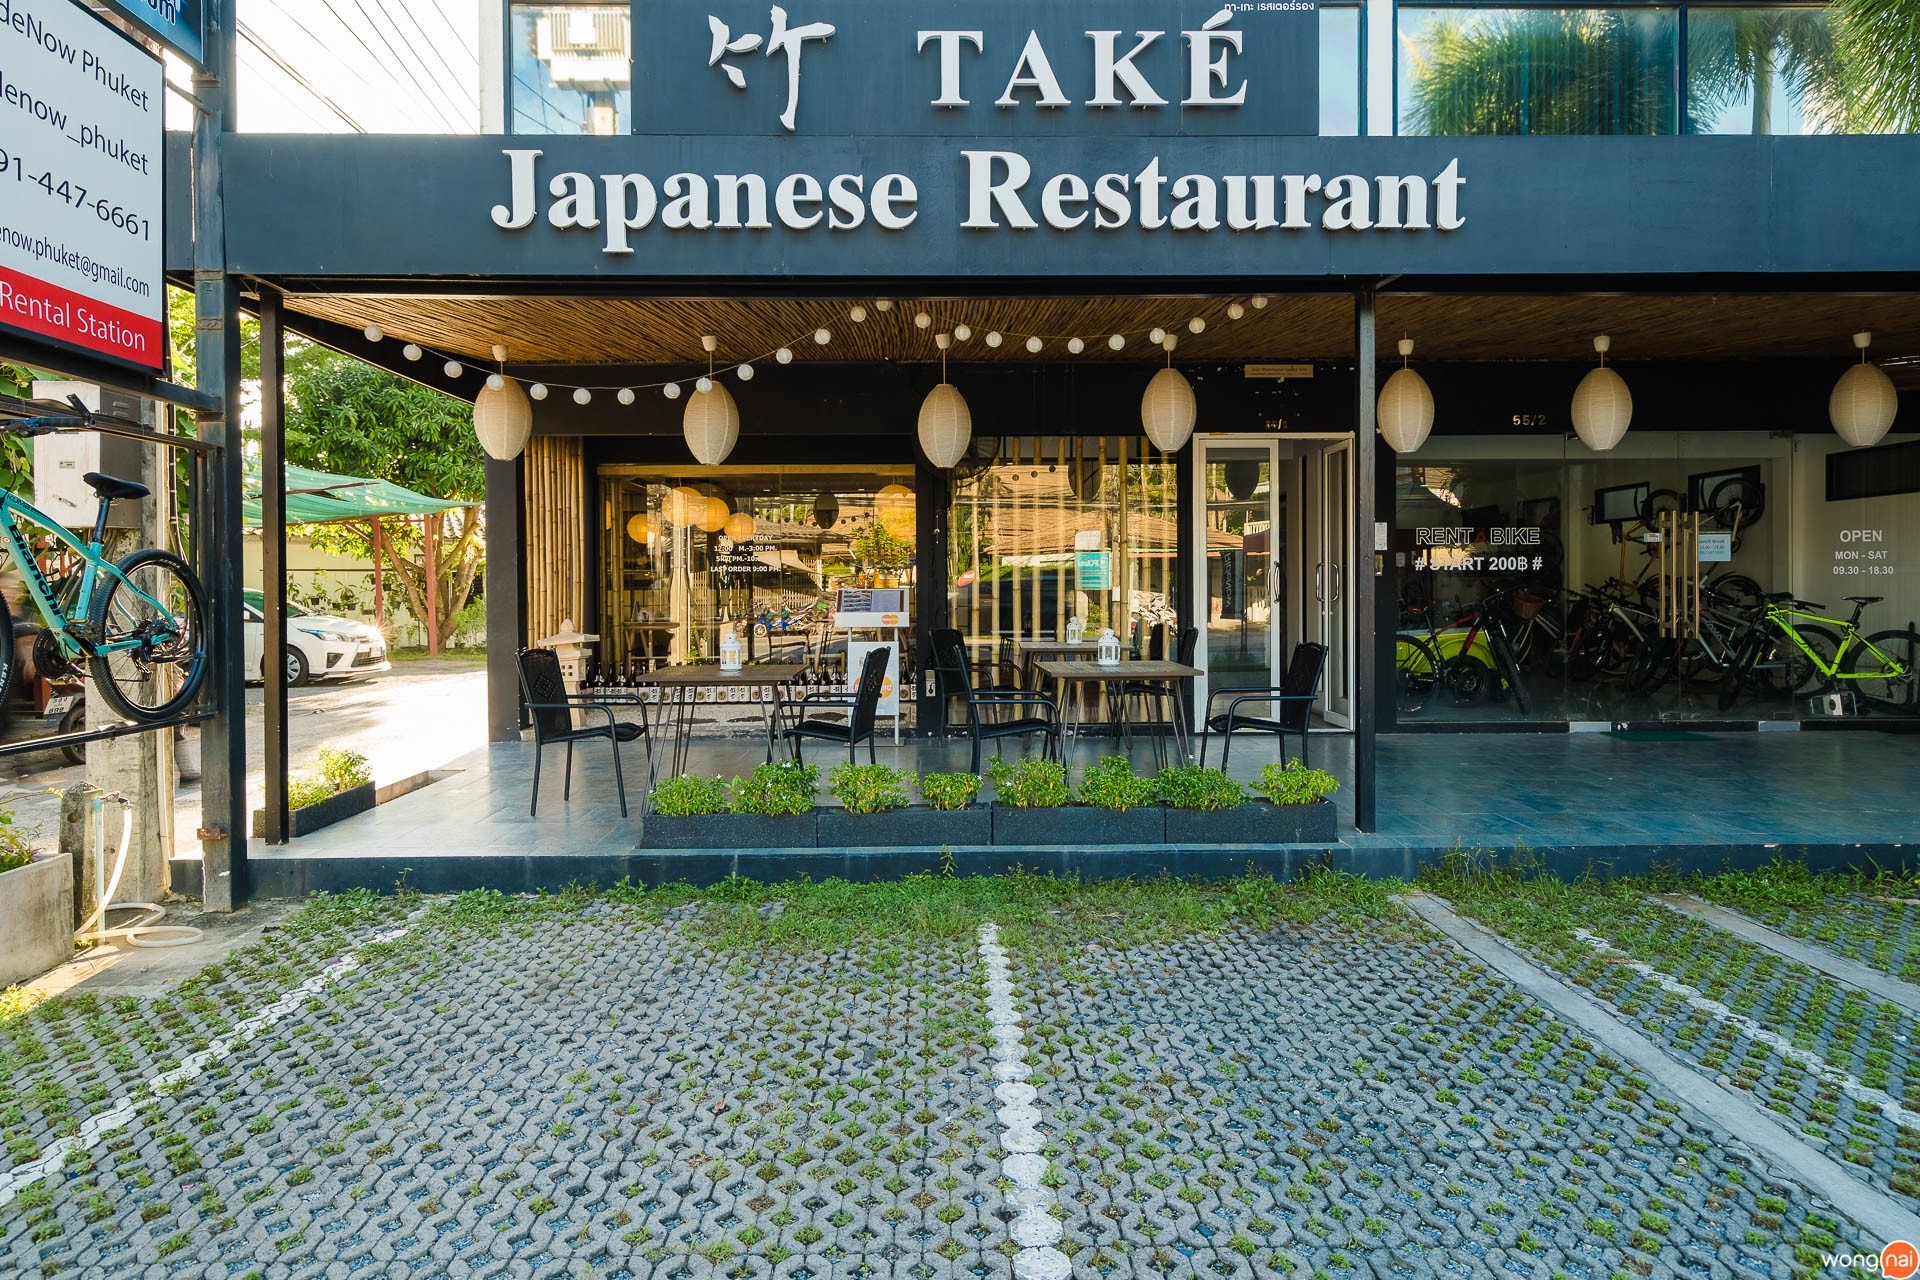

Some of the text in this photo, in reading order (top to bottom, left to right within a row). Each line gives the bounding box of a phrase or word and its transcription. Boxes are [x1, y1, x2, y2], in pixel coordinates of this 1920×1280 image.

[82, 49, 149, 113] Phuket
[916, 9, 1248, 109] TAKÉ
[0, 70, 149, 176] enow_phuket
[0, 148, 149, 242] 91-447-6661
[490, 149, 1467, 254] Japanese Restaurant
[0, 226, 150, 298] now.phuket@gmail.com
[0, 280, 146, 352] Rental Station
[1513, 414, 1547, 426] 55/2
[1416, 527, 1474, 545] RENT
[1490, 527, 1541, 545] BIKE
[1430, 557, 1485, 571] START
[1835, 551, 1859, 560] MON
[1867, 550, 1888, 560] SAT
[1839, 530, 1883, 542] OPEN
[8, 524, 64, 617] Bianchi
[1832, 566, 1860, 575] 09.30
[1868, 566, 1894, 575] 18.30
[0, 662, 9, 693] KEN
